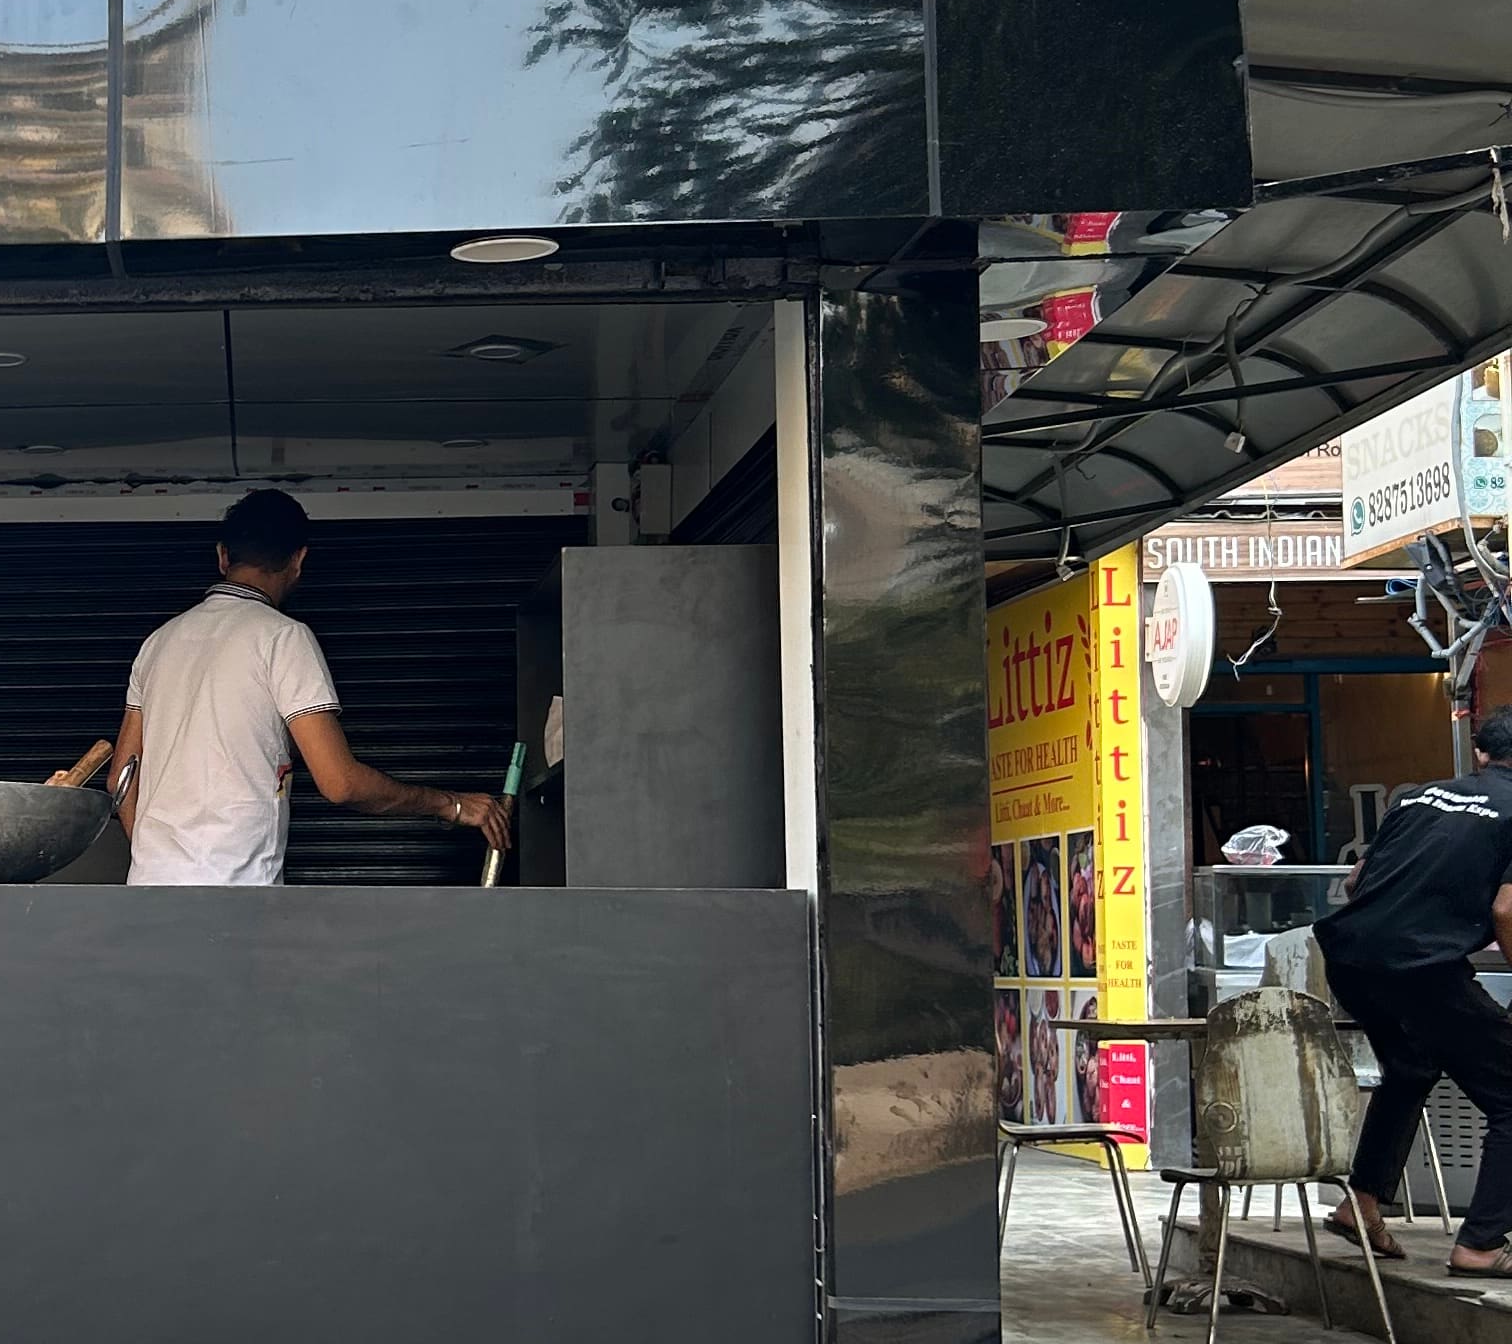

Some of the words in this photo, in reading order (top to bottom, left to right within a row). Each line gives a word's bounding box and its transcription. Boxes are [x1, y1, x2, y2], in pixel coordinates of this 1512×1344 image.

[1368, 461, 1451, 527] 8287513698
[1147, 536, 1238, 569] SOUTH
[1248, 535, 1341, 568] INDIAN
[1014, 745, 1035, 777] FOR
[1037, 735, 1078, 771] HEALTH
[1108, 978, 1142, 989] HEALTH
